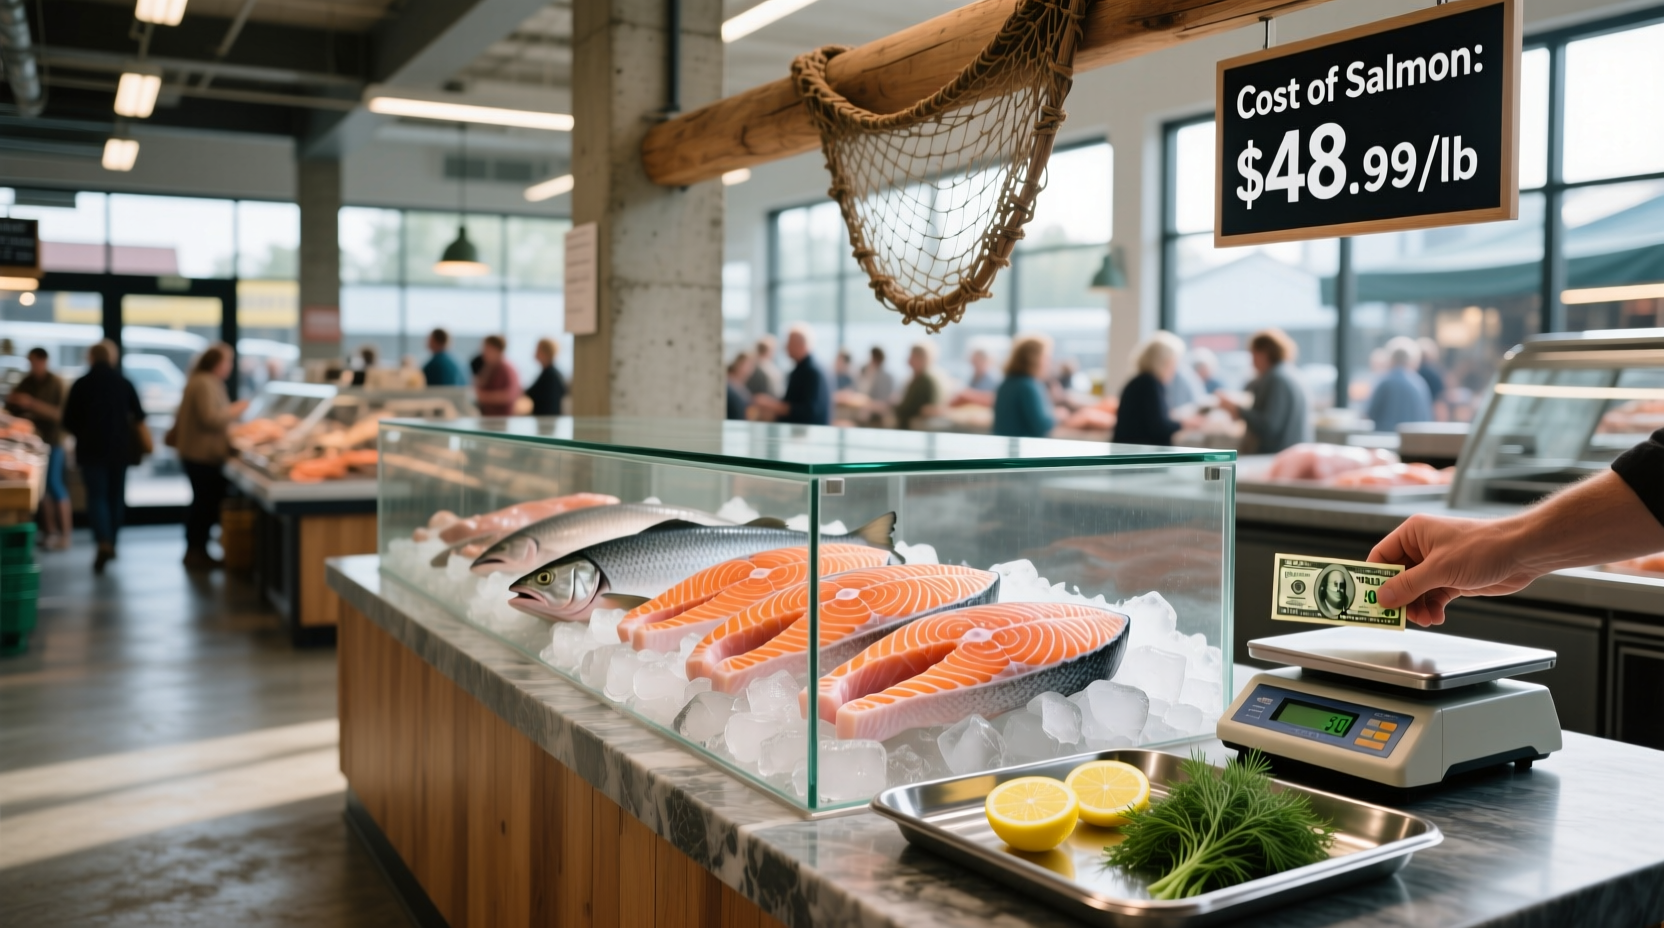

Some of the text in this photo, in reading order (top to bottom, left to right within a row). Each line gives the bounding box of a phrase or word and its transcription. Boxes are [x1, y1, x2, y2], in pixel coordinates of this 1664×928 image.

[1236, 44, 1483, 119] Cost of Salmon:
[1236, 122, 1478, 210] $48.99/lb
